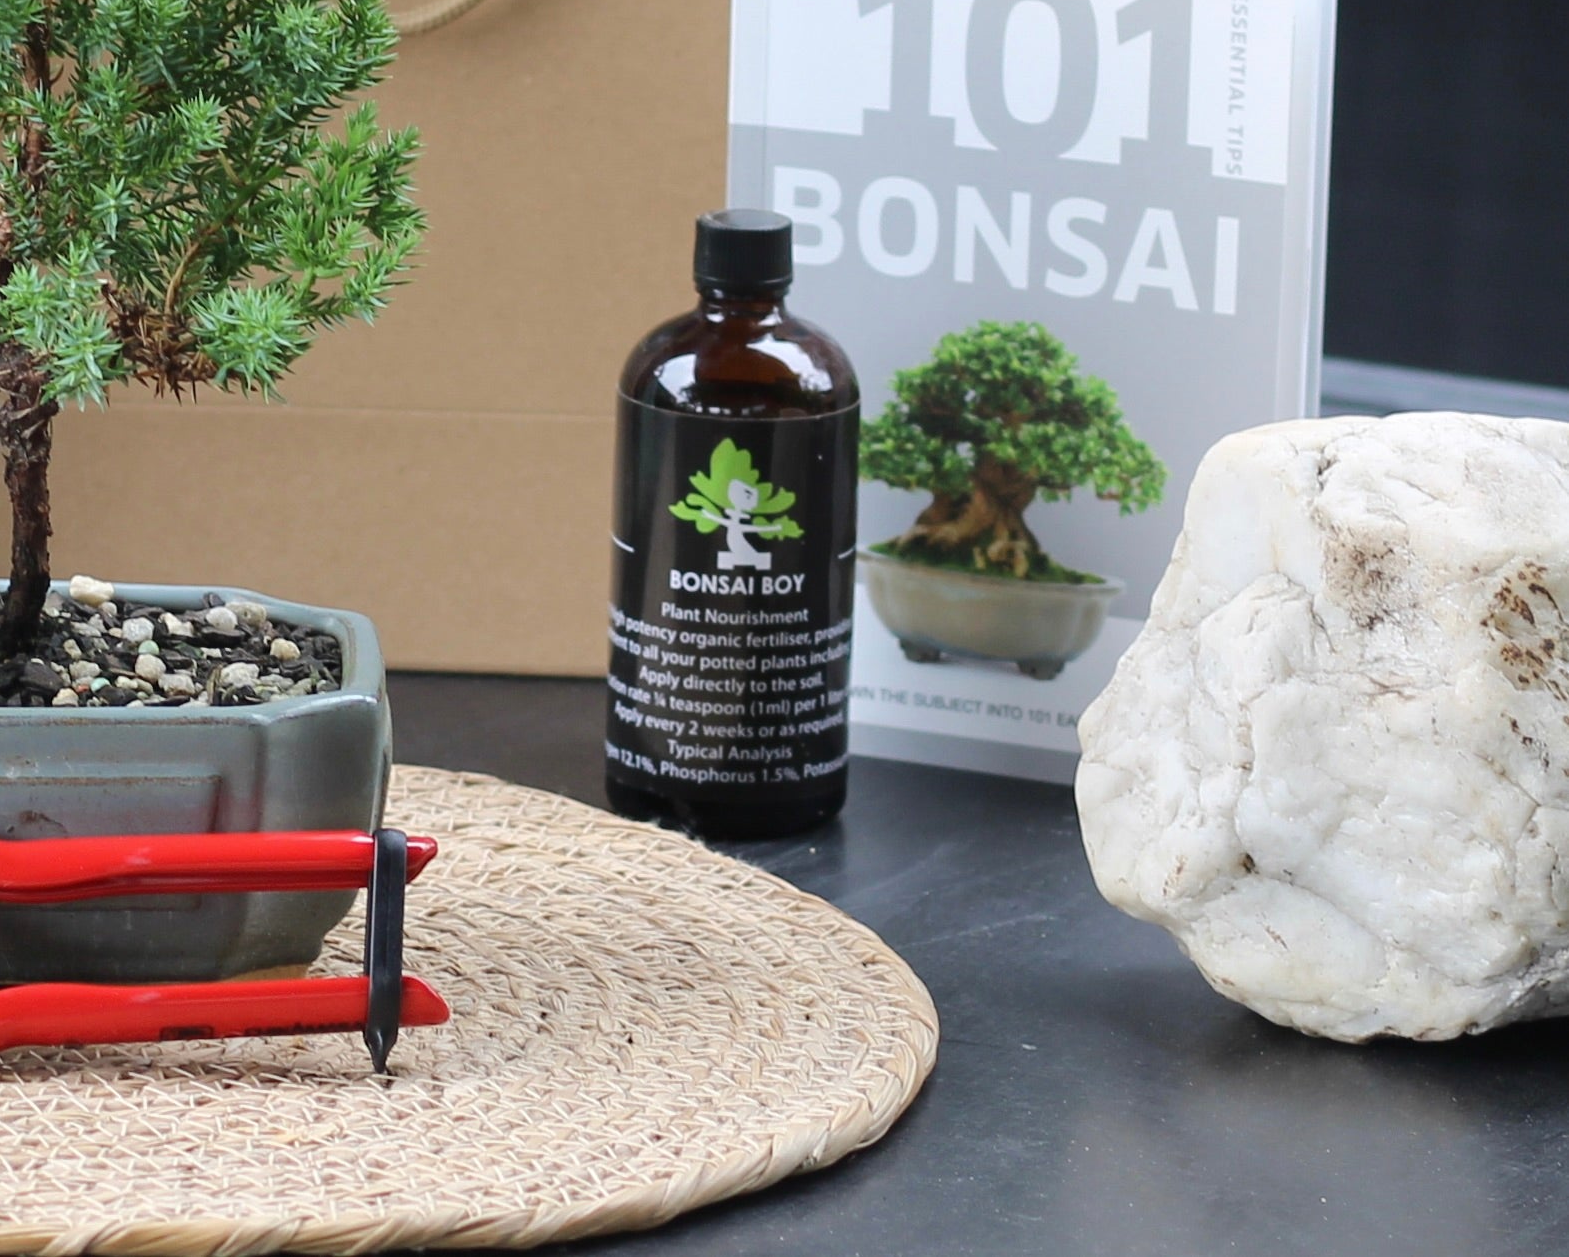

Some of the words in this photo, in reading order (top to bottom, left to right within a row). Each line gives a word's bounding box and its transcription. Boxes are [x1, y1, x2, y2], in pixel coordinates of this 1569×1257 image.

[1225, 125, 1244, 176] TIPS
[773, 165, 1240, 316] BONSAI
[669, 569, 754, 595] BONSAI
[761, 573, 806, 595] BOY
[661, 602, 701, 623] Plant
[704, 608, 809, 625] Nourishment
[626, 617, 677, 644] potency
[679, 630, 741, 649] organic
[642, 644, 659, 660] all
[661, 649, 696, 666] your
[700, 655, 756, 672] potted
[761, 654, 807, 672] plants
[639, 665, 680, 691] Apply
[683, 674, 745, 696] directly
[750, 679, 767, 693] to
[771, 677, 797, 692] the
[615, 700, 643, 728] Apply
[644, 715, 685, 736] every
[688, 720, 699, 736] 2
[702, 723, 754, 738] weeks
[758, 725, 776, 738] or
[779, 724, 796, 737] as
[669, 695, 745, 717] teaspoon
[750, 699, 790, 718] (1ml)
[794, 698, 817, 716] per
[878, 688, 909, 706] THE
[912, 692, 983, 715] SUBJECT
[987, 703, 1024, 721] INTO
[667, 738, 723, 761] Typical
[728, 745, 793, 763] Analysis
[660, 760, 756, 784] Phosphorus
